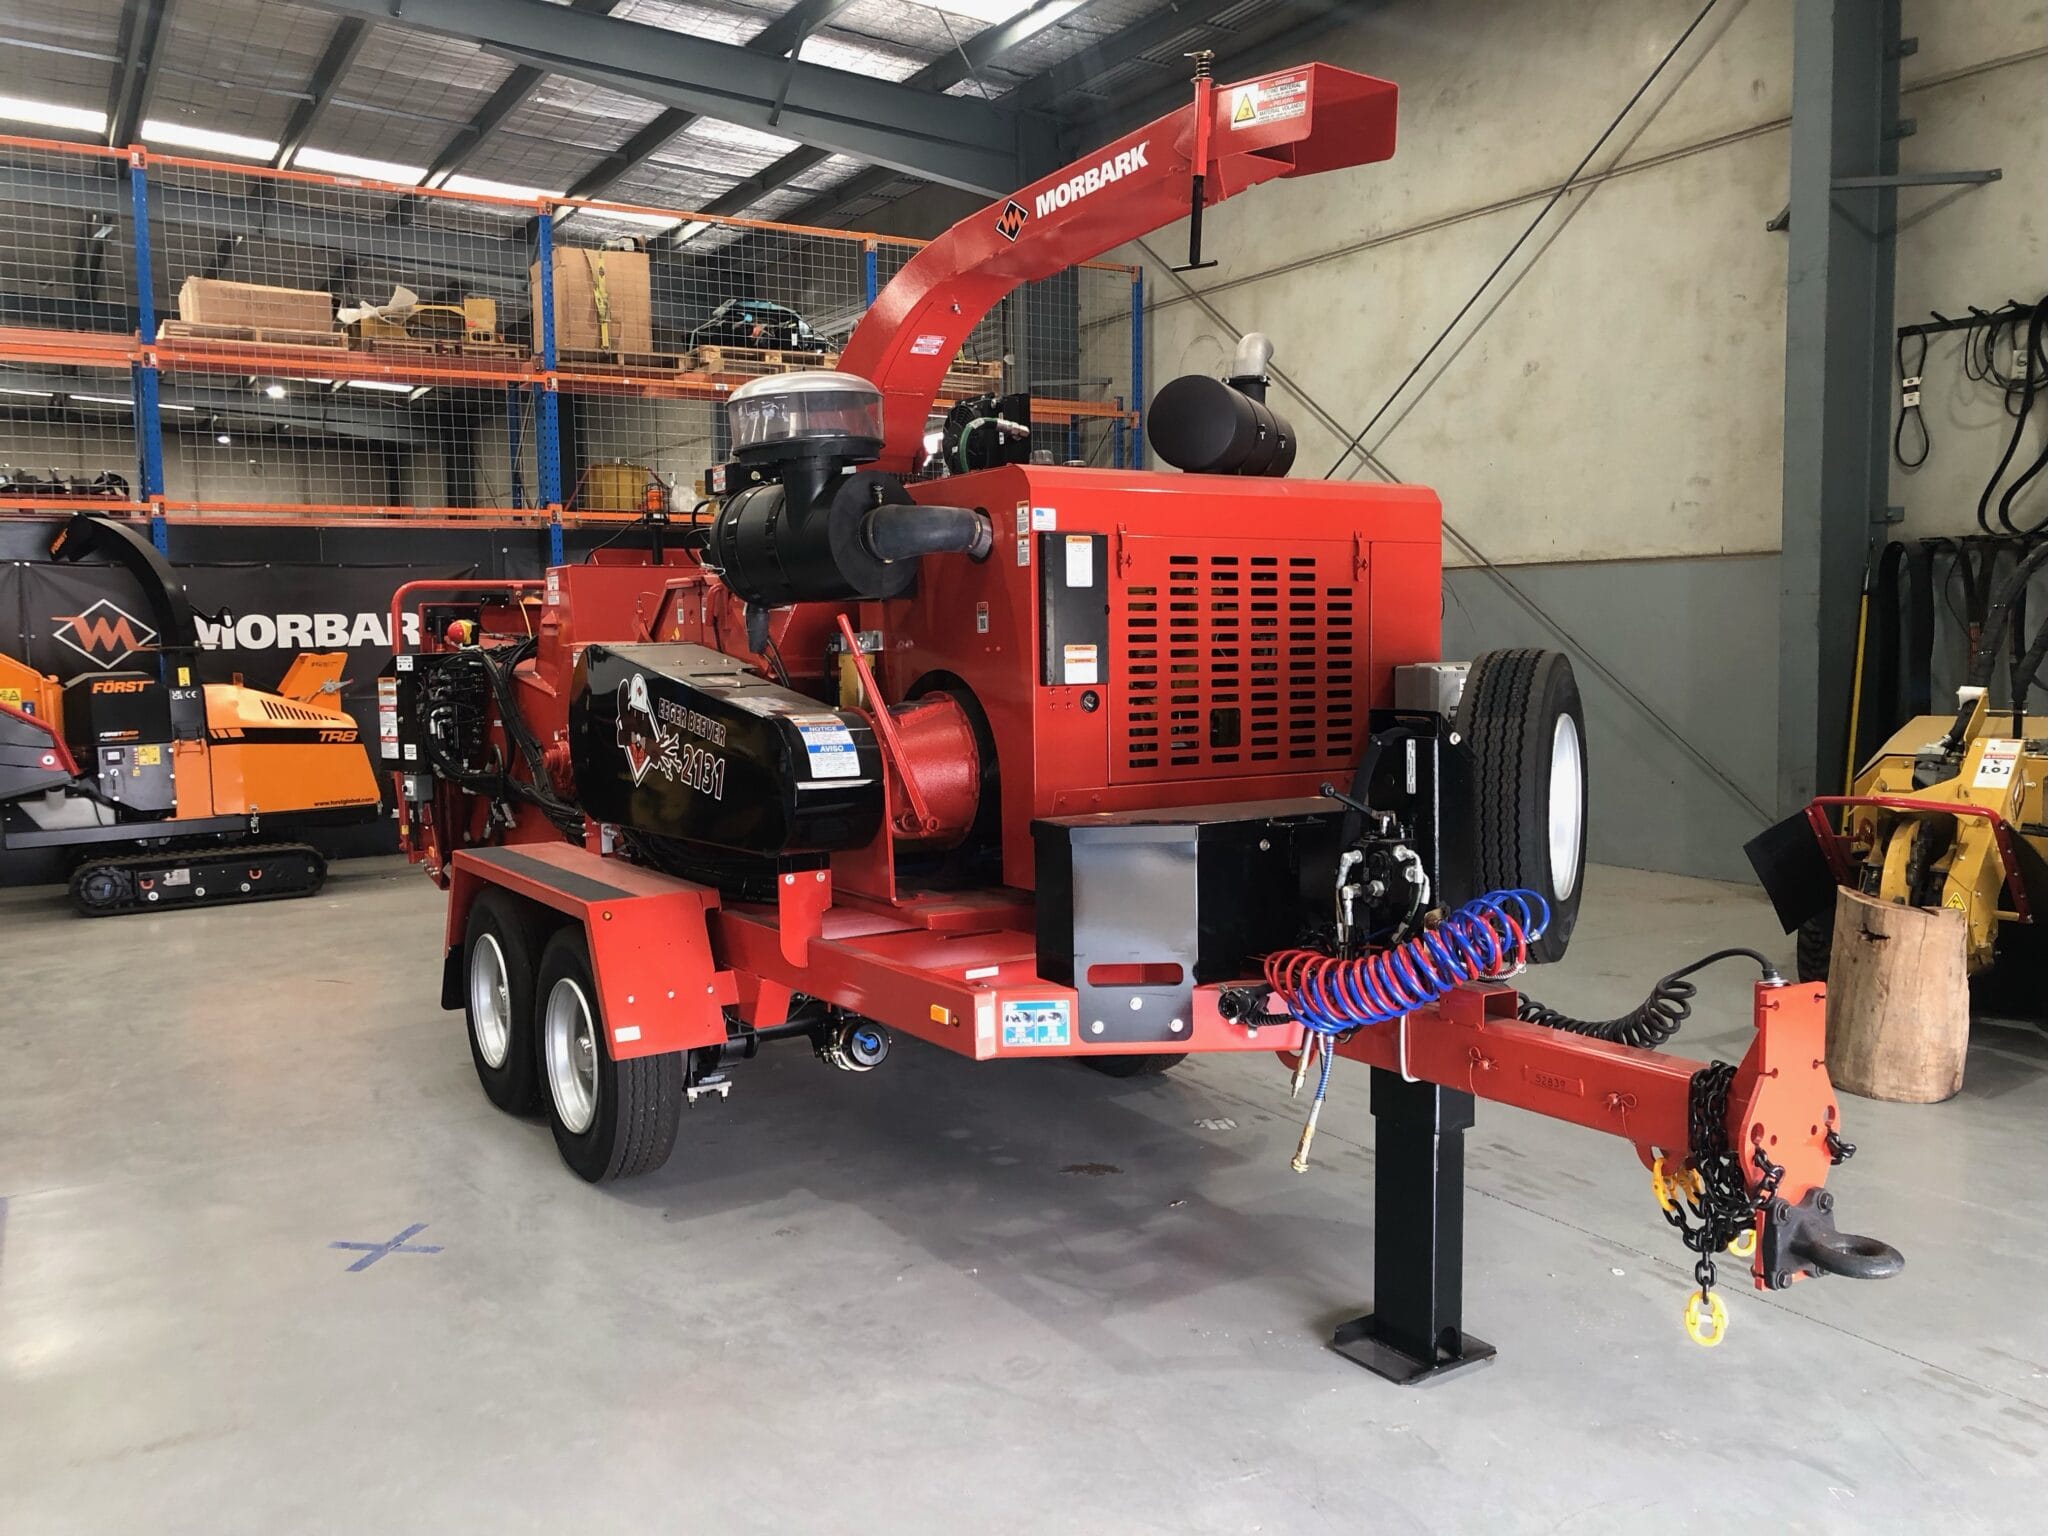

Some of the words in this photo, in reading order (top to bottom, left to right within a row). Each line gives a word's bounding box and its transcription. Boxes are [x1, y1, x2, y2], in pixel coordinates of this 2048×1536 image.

[1035, 142, 1149, 219] MORBARK
[318, 730, 359, 743] TR8
[657, 697, 688, 729] EEGER
[687, 710, 727, 748] BEEVER
[680, 743, 726, 801] 2131
[819, 745, 845, 753] AVISO
